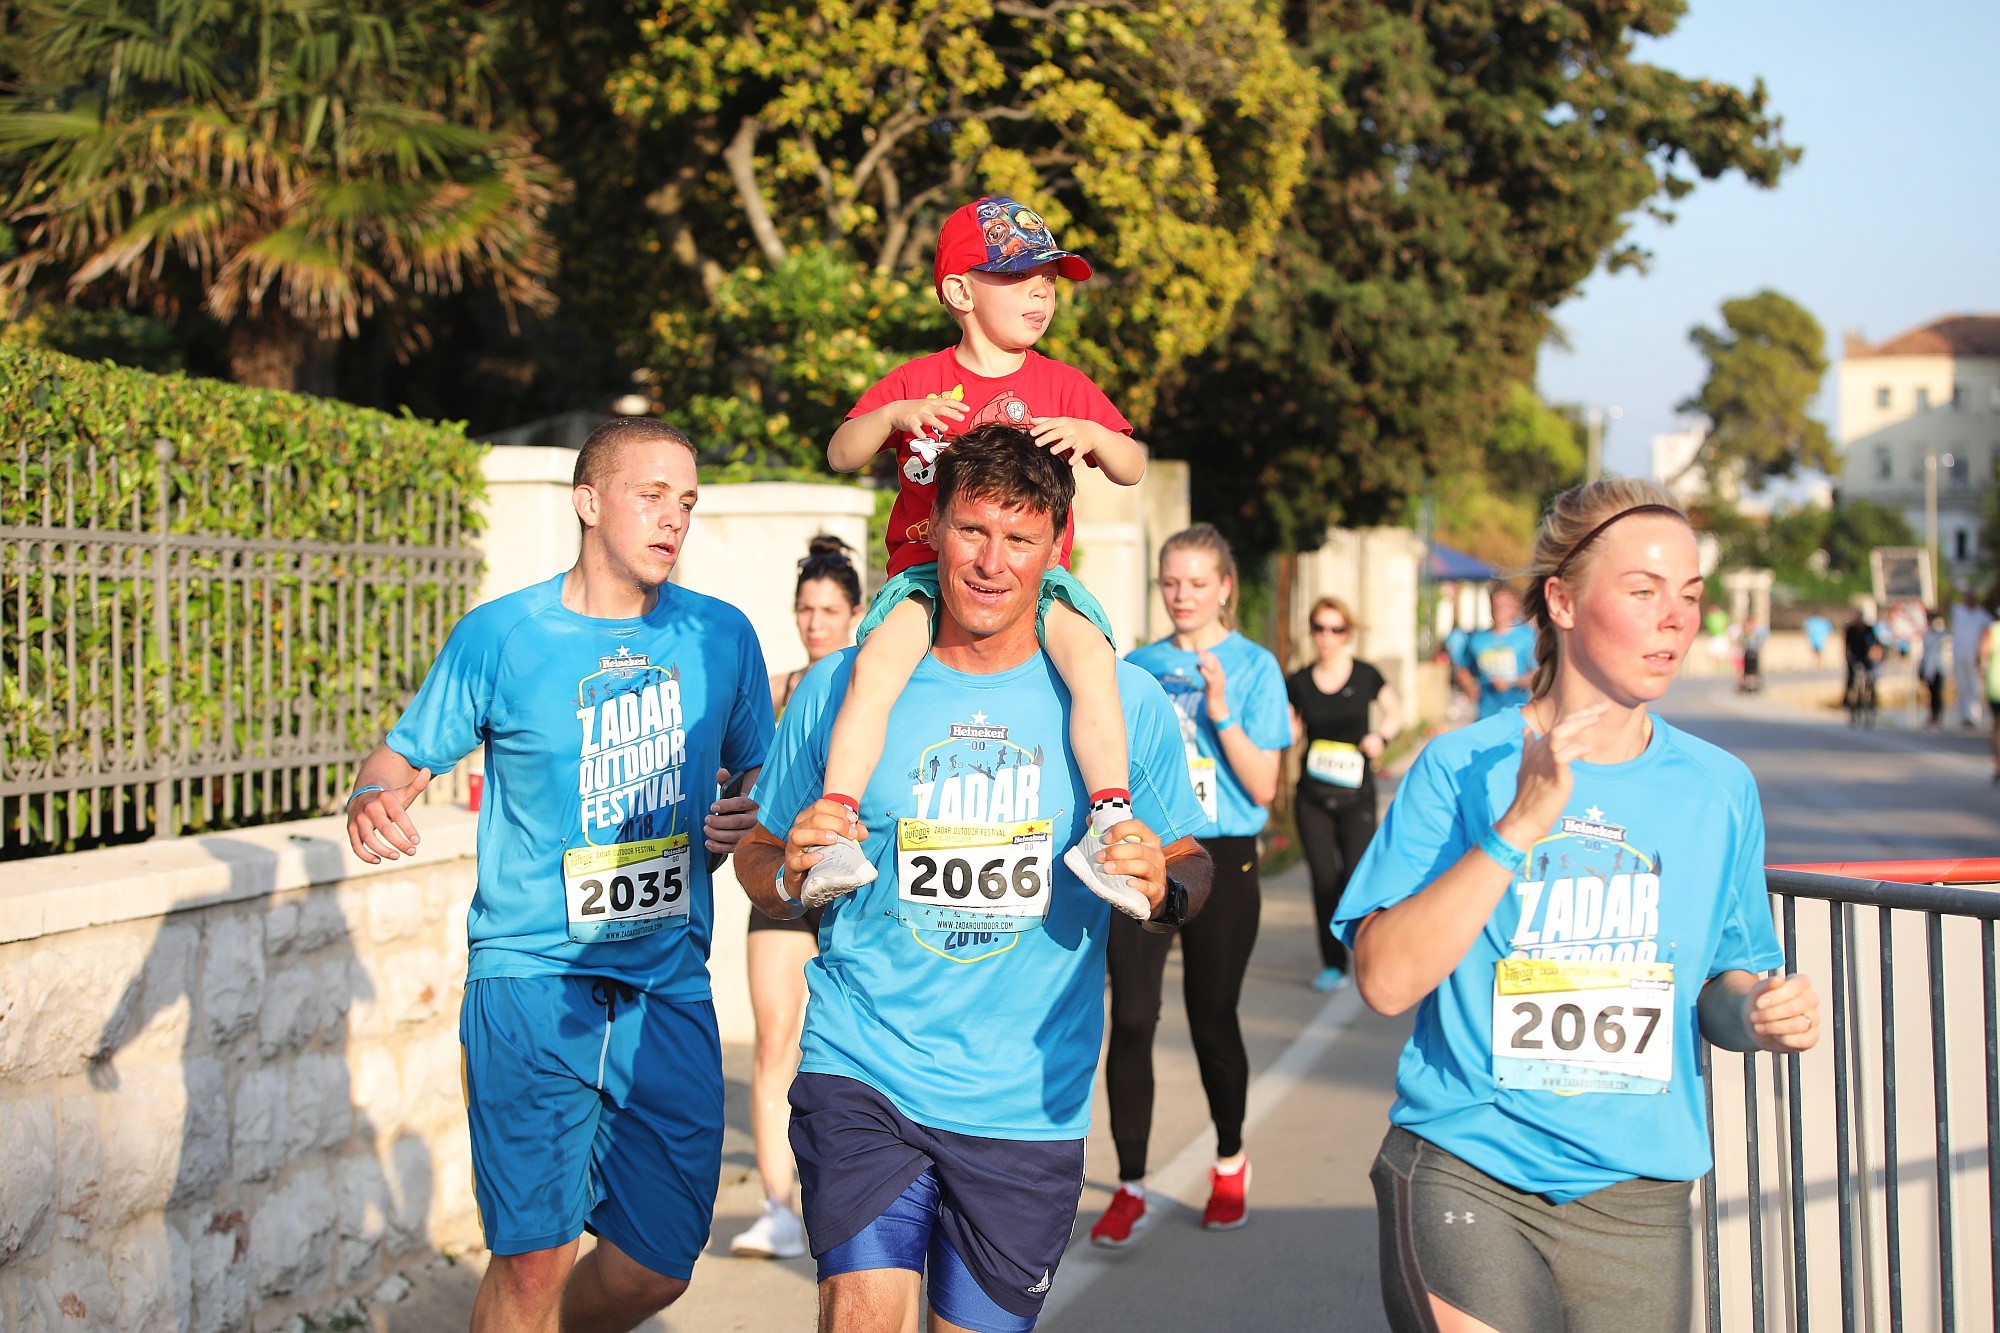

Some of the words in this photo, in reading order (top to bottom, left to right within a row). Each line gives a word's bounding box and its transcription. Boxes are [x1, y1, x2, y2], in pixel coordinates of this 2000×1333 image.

[602, 657, 648, 668] Heineken
[576, 679, 683, 758] ZADAR
[952, 726, 1006, 740] Heineken
[578, 729, 686, 797] OUTDOOR
[581, 770, 686, 834] FESTIVAL
[912, 763, 1041, 823] ZADAR
[635, 845, 657, 854] FESTIVAL
[934, 826, 951, 835] ZADAR
[980, 828, 1005, 837] FESTIVAL
[1564, 819, 1623, 841] Heineken
[580, 865, 682, 915] 2035
[910, 855, 1041, 900] 2066
[937, 920, 1014, 930] WWW.ZADAROUTDOOR.COM
[1513, 872, 1660, 946] ZADAR
[1510, 1001, 1662, 1055] 2067
